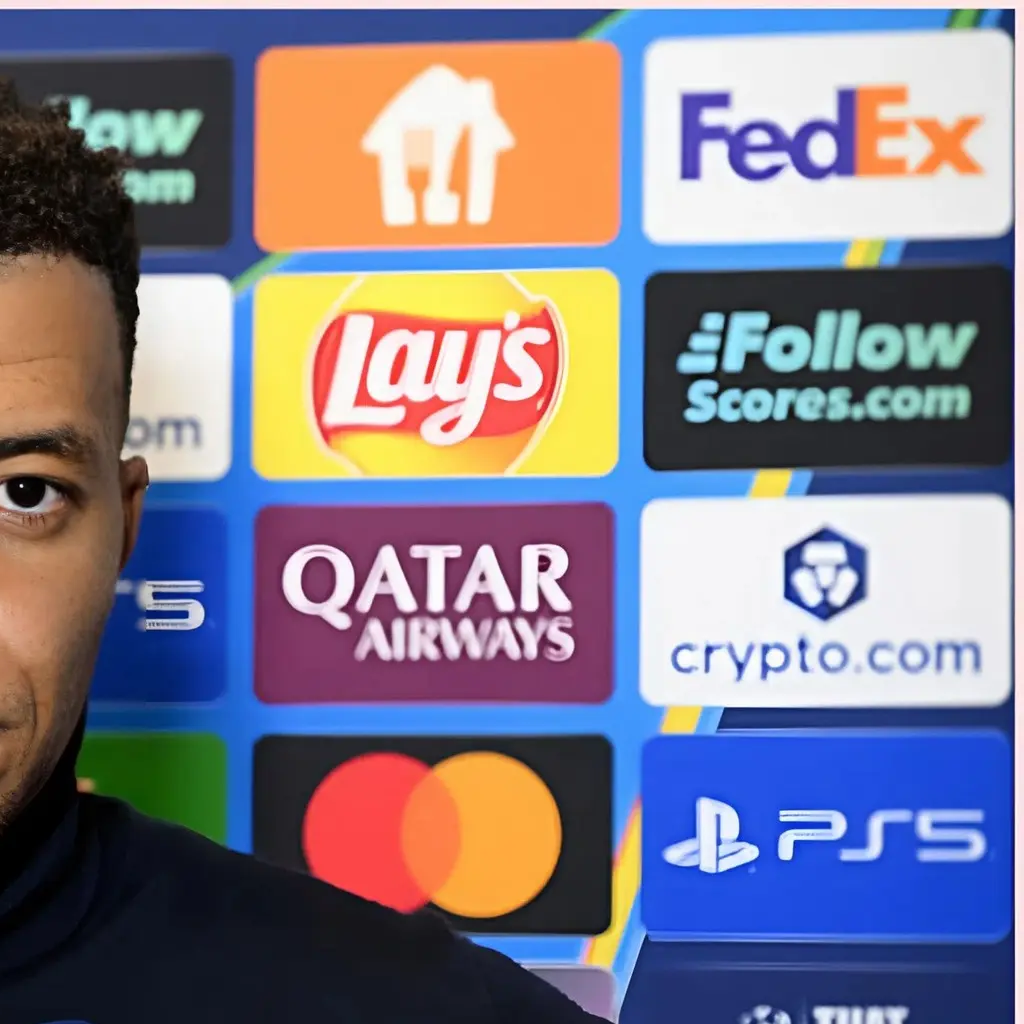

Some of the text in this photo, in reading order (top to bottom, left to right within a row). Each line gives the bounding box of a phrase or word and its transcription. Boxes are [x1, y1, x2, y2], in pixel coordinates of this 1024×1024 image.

[680, 84, 984, 181] FedEx
[721, 310, 977, 373] Follow
[322, 311, 552, 446] Lay's
[684, 379, 971, 423] Scores.com
[282, 543, 573, 631] QATAR
[354, 616, 575, 662] AIRWAYS
[671, 636, 982, 681] crypto.com
[777, 809, 988, 862] PS5
